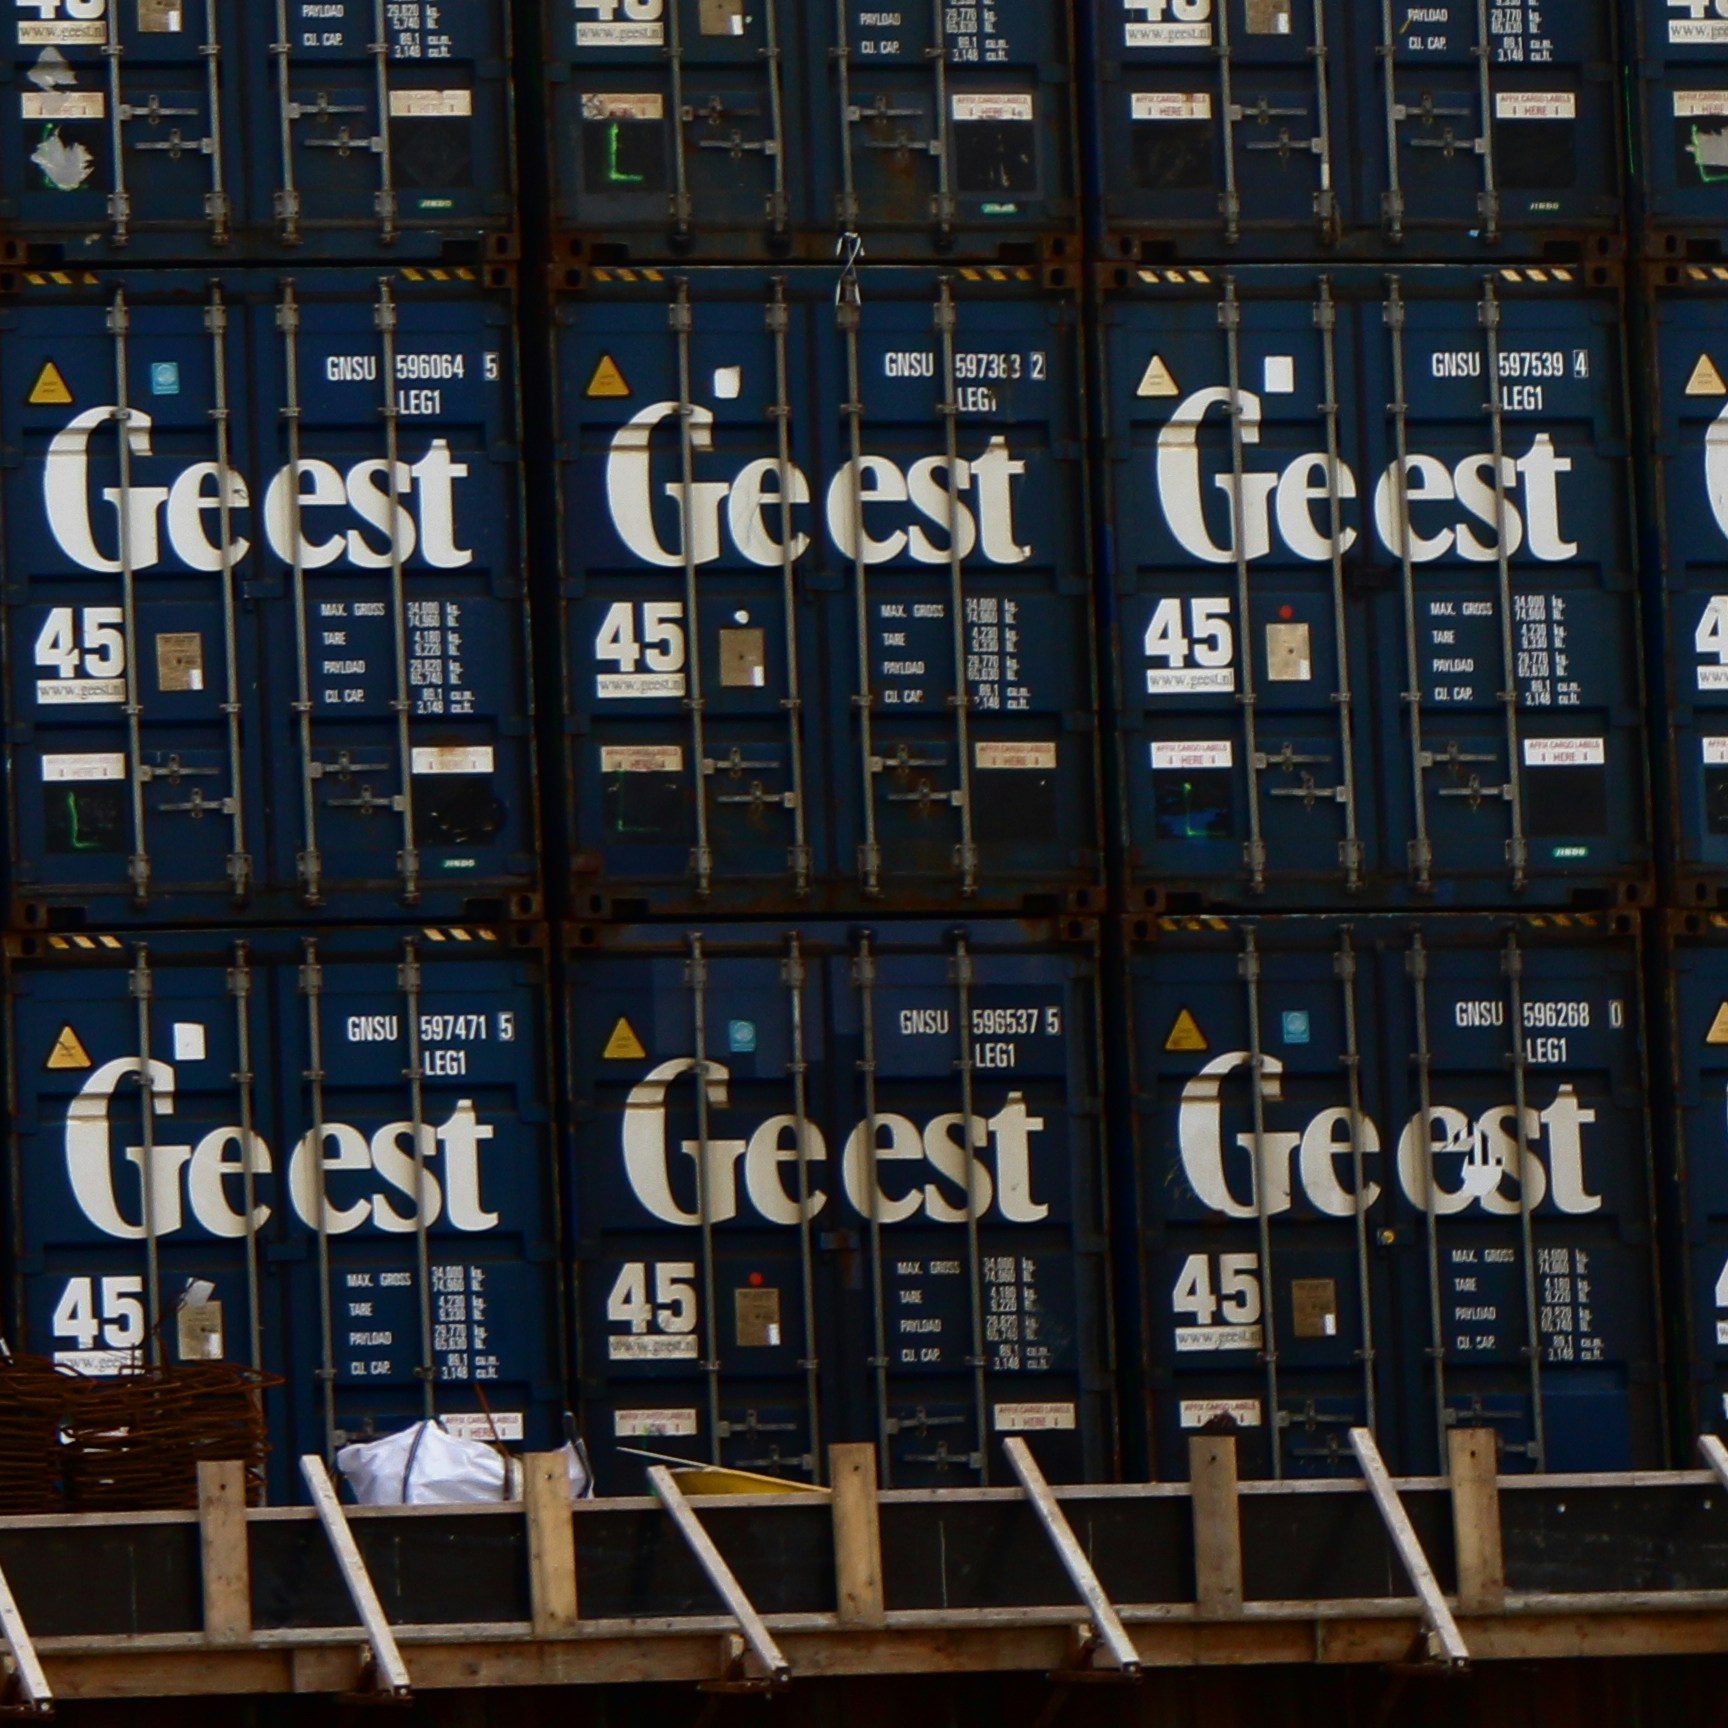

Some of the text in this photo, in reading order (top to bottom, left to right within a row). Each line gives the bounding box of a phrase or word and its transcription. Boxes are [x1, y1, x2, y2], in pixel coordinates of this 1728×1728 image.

[328, 356, 375, 380] GNSU
[397, 355, 463, 378] 596064
[400, 390, 439, 414] LEG1
[43, 405, 471, 572] Geest
[606, 401, 1030, 567] Geest
[1157, 386, 1578, 563] Geest
[596, 603, 682, 672] 45
[1145, 598, 1232, 667] 45
[348, 1016, 397, 1041] GNSU
[421, 1015, 485, 1040] 597471
[1456, 1002, 1502, 1026] GNSU
[1524, 1003, 1589, 1026] 596268
[426, 1051, 465, 1075] LEG1
[1527, 1038, 1566, 1062] LEG1
[66, 1058, 499, 1238] Geest
[623, 1058, 1049, 1226] Geest
[1179, 1051, 1602, 1217] Geest
[54, 1277, 143, 1348] 45
[608, 1263, 695, 1333] 45
[1173, 1254, 1258, 1324] 45
